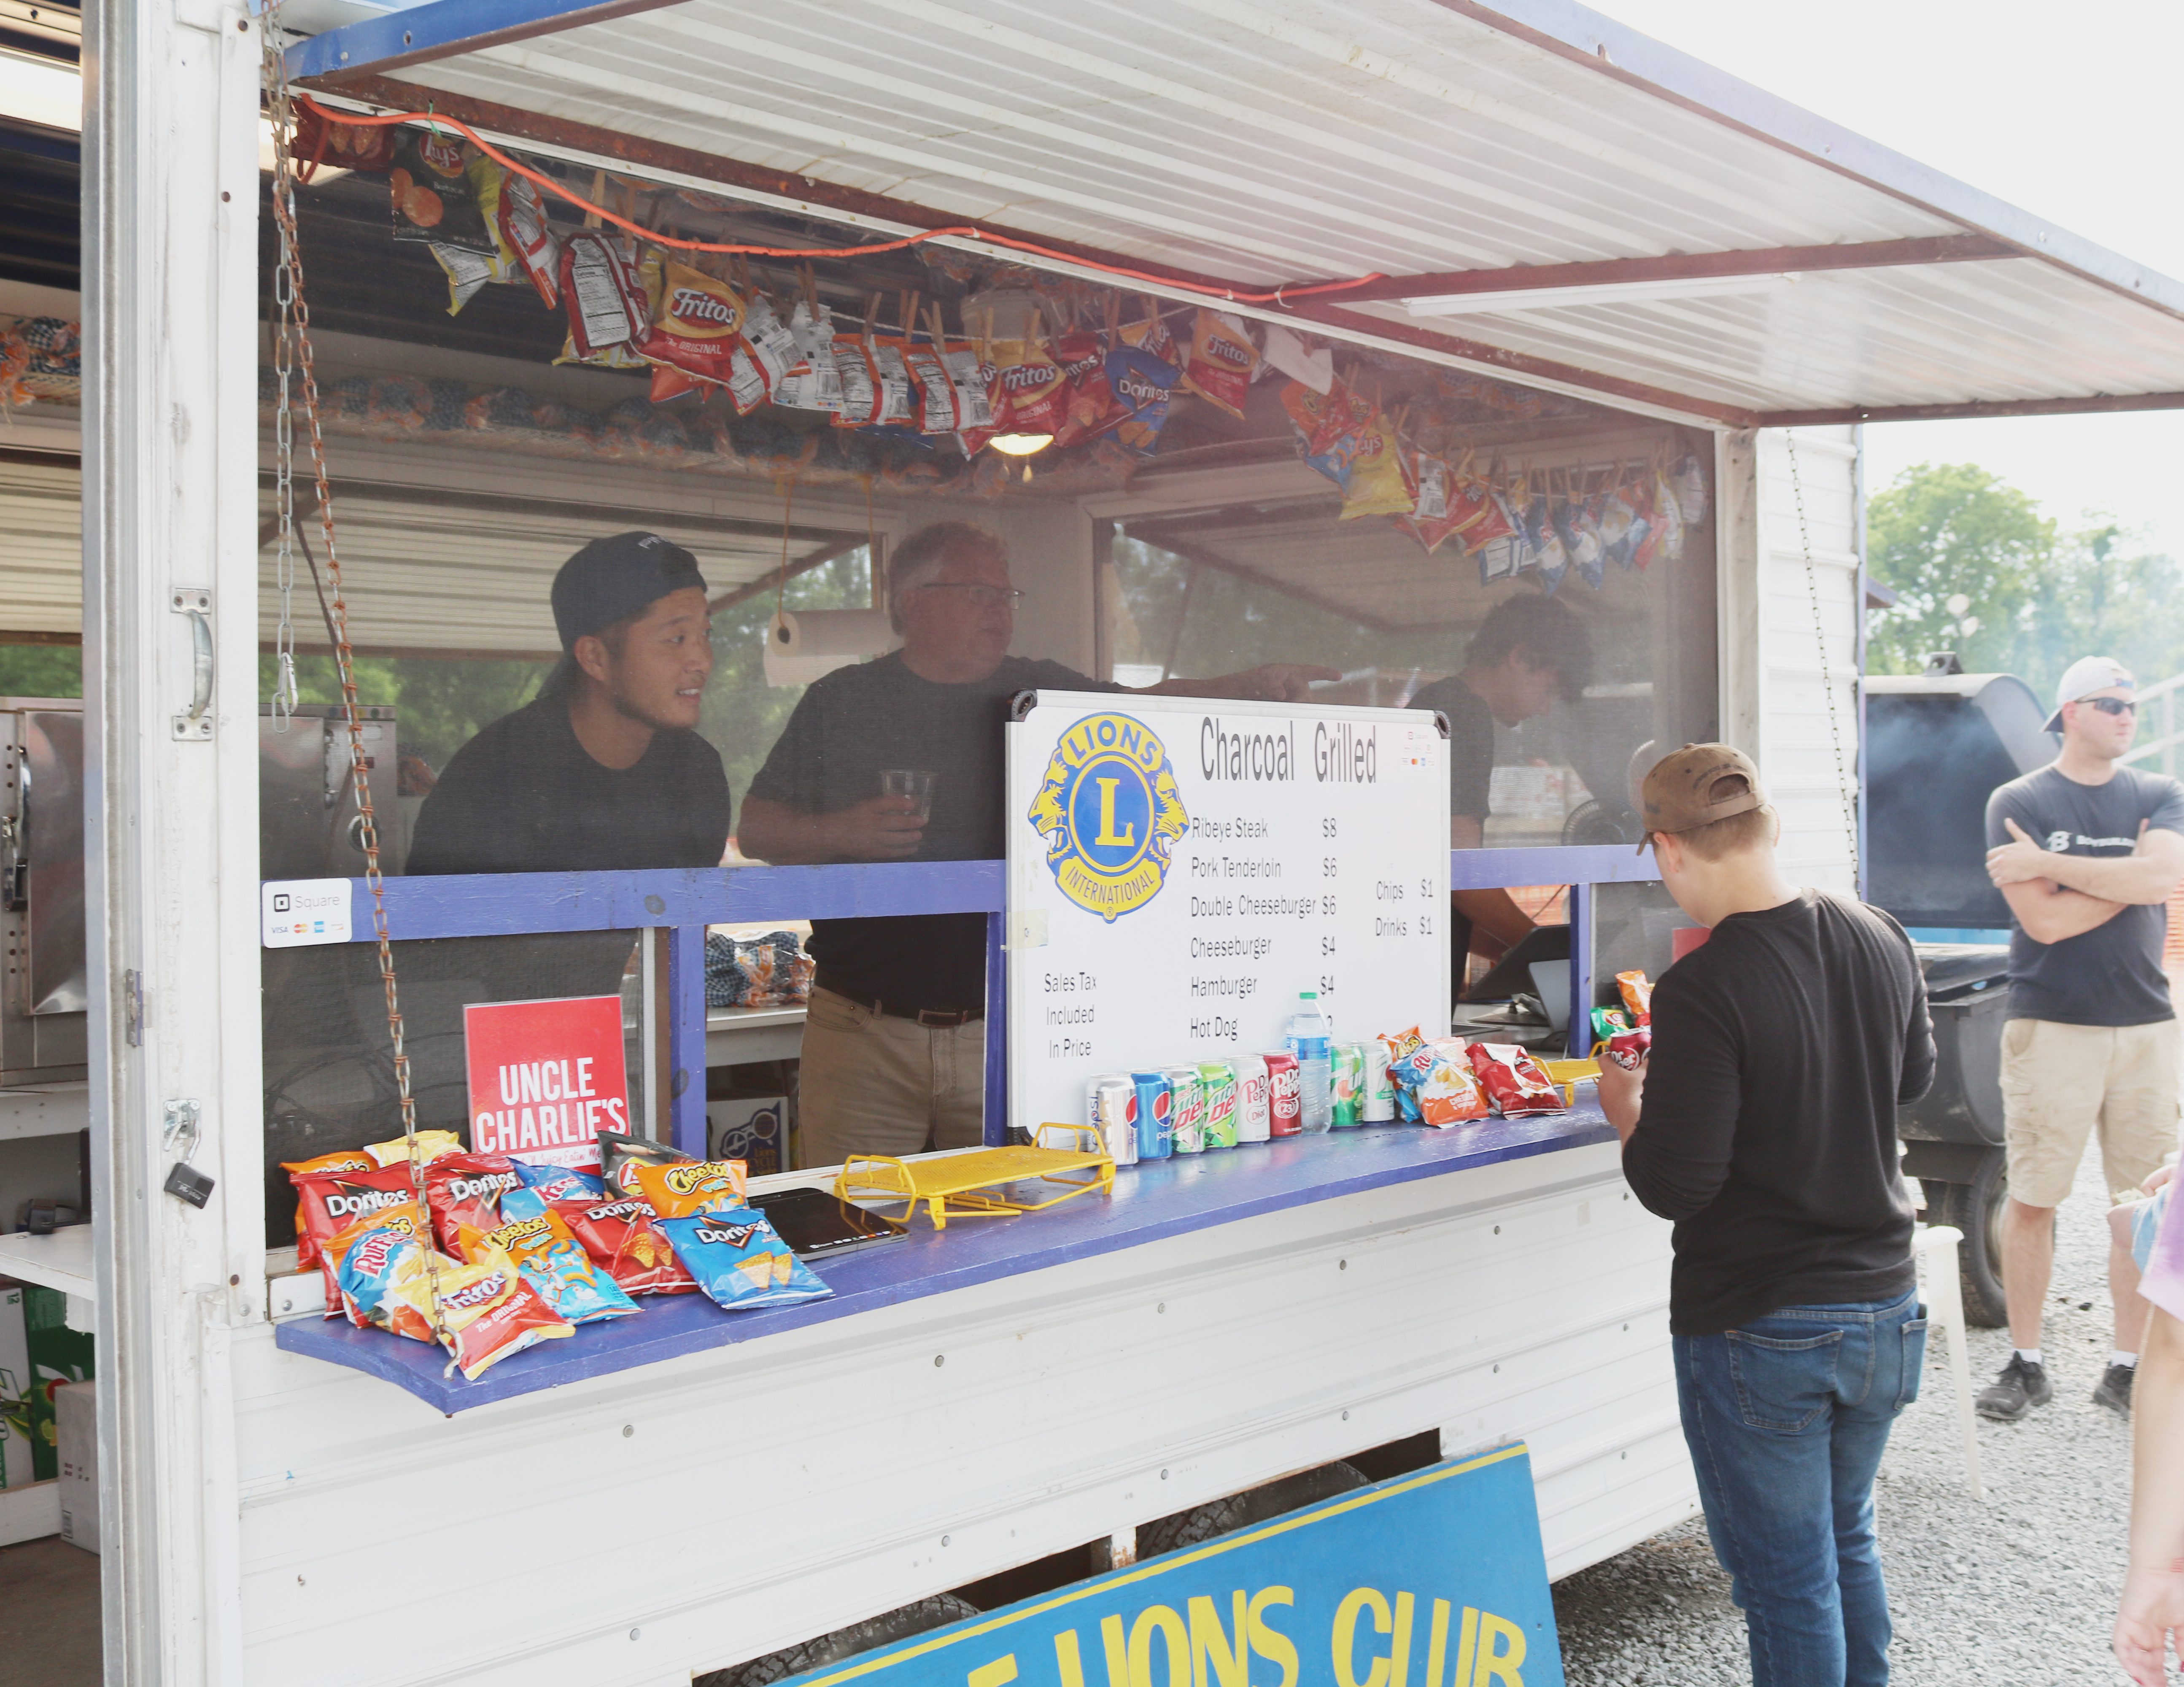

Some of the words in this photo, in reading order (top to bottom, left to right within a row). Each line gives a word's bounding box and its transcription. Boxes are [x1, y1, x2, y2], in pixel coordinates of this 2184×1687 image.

[671, 288, 736, 324] Fritos
[679, 341, 722, 355] ORIGINAL
[1209, 334, 1249, 364] Fritos
[999, 364, 1056, 391] Fritos
[1065, 354, 1098, 376] ritos
[1119, 379, 1170, 401] Doritos
[1068, 720, 1157, 766] LIONS
[1201, 717, 1294, 782] Charcoal
[1315, 721, 1376, 783] Grilled
[1095, 777, 1135, 846] L
[1192, 817, 1231, 843] Ribeye
[1235, 817, 1268, 839] Steak
[1322, 817, 1337, 838] $8
[1192, 857, 1219, 878] Pork
[1222, 856, 1281, 878] Tenderloin
[1323, 857, 1337, 878] $6
[1065, 866, 1155, 905] INTERNATIONAL
[1376, 881, 1404, 903] Chips
[1421, 878, 1433, 899] $1
[295, 896, 340, 910] Square
[1192, 896, 1232, 917] Double
[1239, 895, 1316, 919] Cheeseburger
[1322, 895, 1337, 916] $6
[1376, 917, 1407, 936] Drinks
[1420, 915, 1432, 936] $1
[1191, 935, 1271, 960] Cheeseburger
[1321, 936, 1336, 957] $4
[1044, 973, 1075, 993] Sales
[1079, 972, 1097, 991] Tax
[1191, 975, 1257, 1000] Hamburger
[1320, 975, 1335, 996] $4
[1047, 1004, 1094, 1026] Included
[1191, 1017, 1211, 1038] Hot
[1216, 1016, 1238, 1041] Dog
[1049, 1039, 1059, 1059] In
[1064, 1038, 1091, 1058] Price
[499, 1057, 596, 1106] UNCLE
[1272, 1073, 1300, 1099] Pepp
[1173, 1100, 1202, 1131] DE
[1208, 1095, 1236, 1125] DE
[1252, 1109, 1265, 1121] Diet
[1282, 1103, 1293, 1114] 23
[476, 1097, 626, 1153] CHARLIE'S
[1157, 1131, 1172, 1141] pep
[450, 1171, 518, 1202] Doritos
[326, 1189, 409, 1216] Doritos
[587, 1202, 657, 1220] Doritos
[482, 1218, 548, 1250] Cheetos
[696, 1219, 771, 1244] Doritos
[435, 1271, 508, 1311] Fritos
[475, 1320, 493, 1333] The
[1331, 1587, 1527, 1687] CLUB
